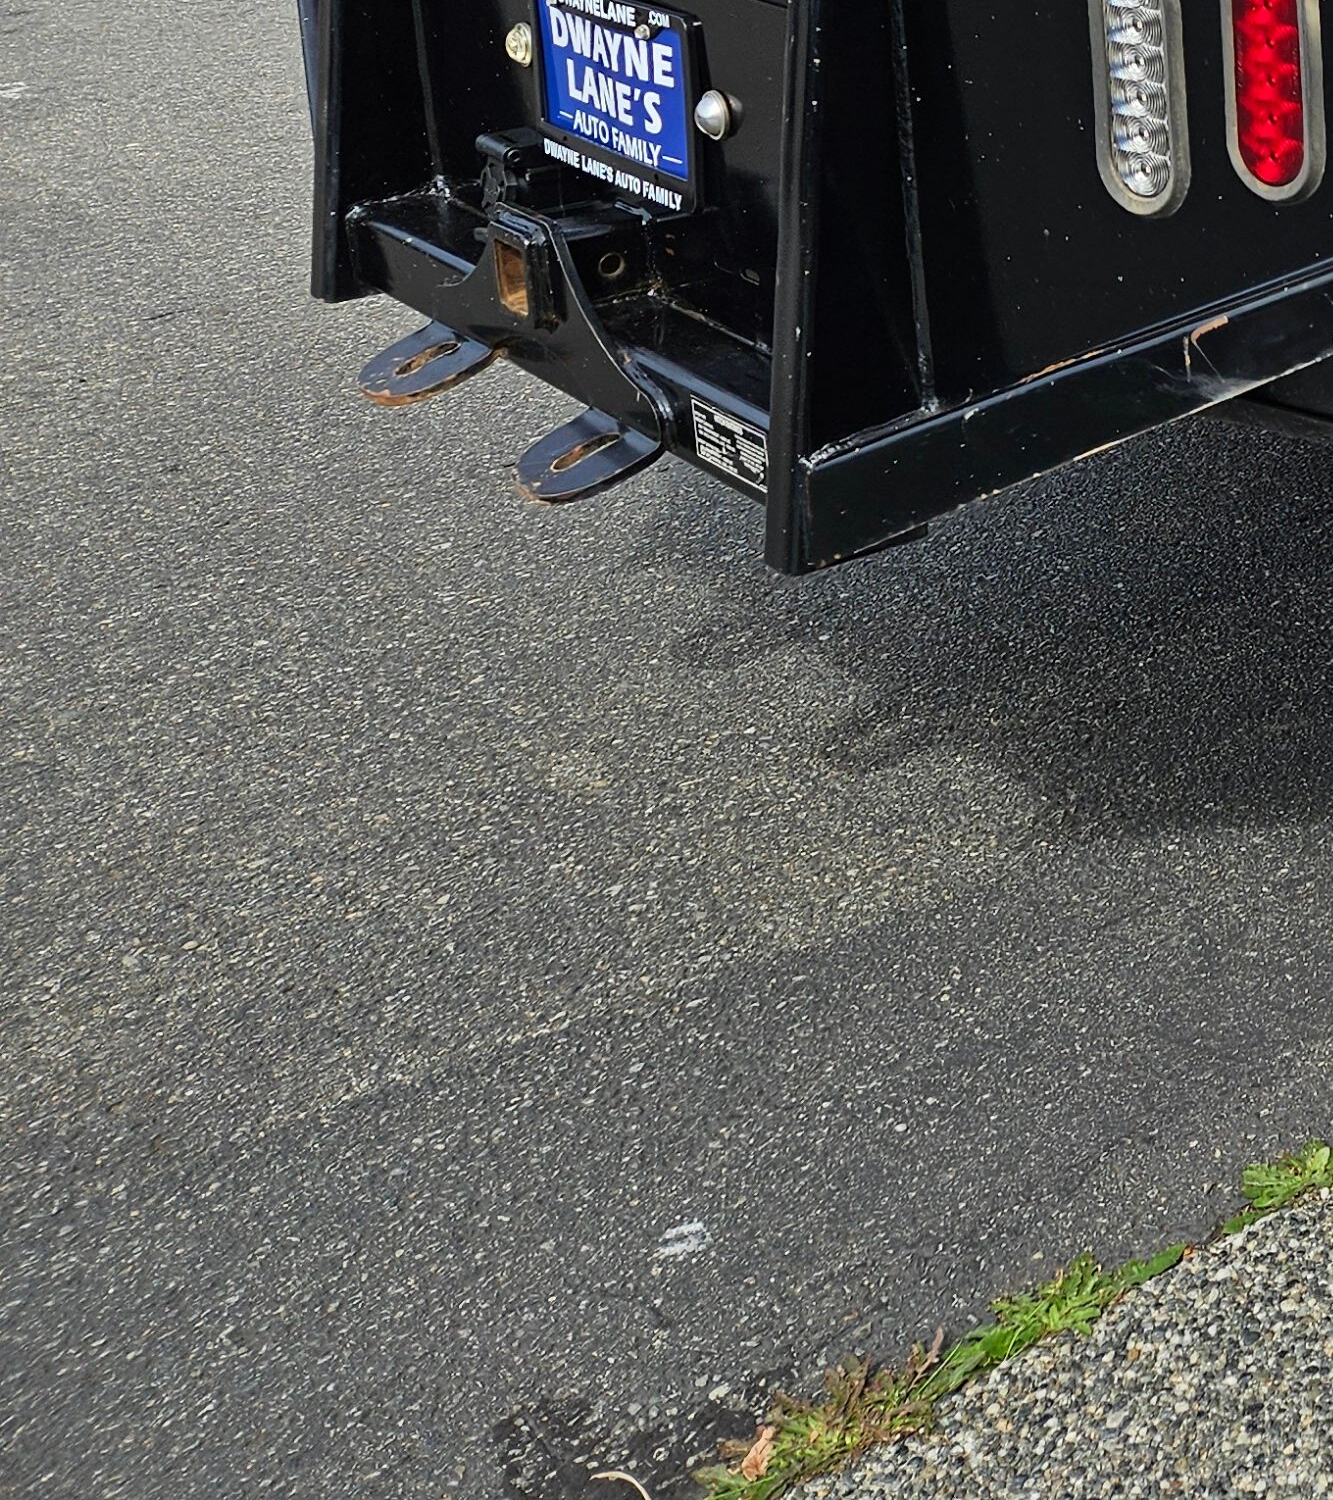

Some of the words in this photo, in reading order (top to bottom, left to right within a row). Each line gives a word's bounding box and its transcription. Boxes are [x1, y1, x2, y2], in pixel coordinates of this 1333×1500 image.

[550, 6, 675, 88] DWAYNE
[566, 58, 663, 135] LANE'S
[543, 138, 580, 167] DWAYNE
[581, 154, 614, 184] LANE'S
[615, 170, 641, 195] AUTO
[642, 182, 682, 212] FAMILY
[573, 110, 610, 144] AUTO
[612, 128, 663, 168] FAMILY
